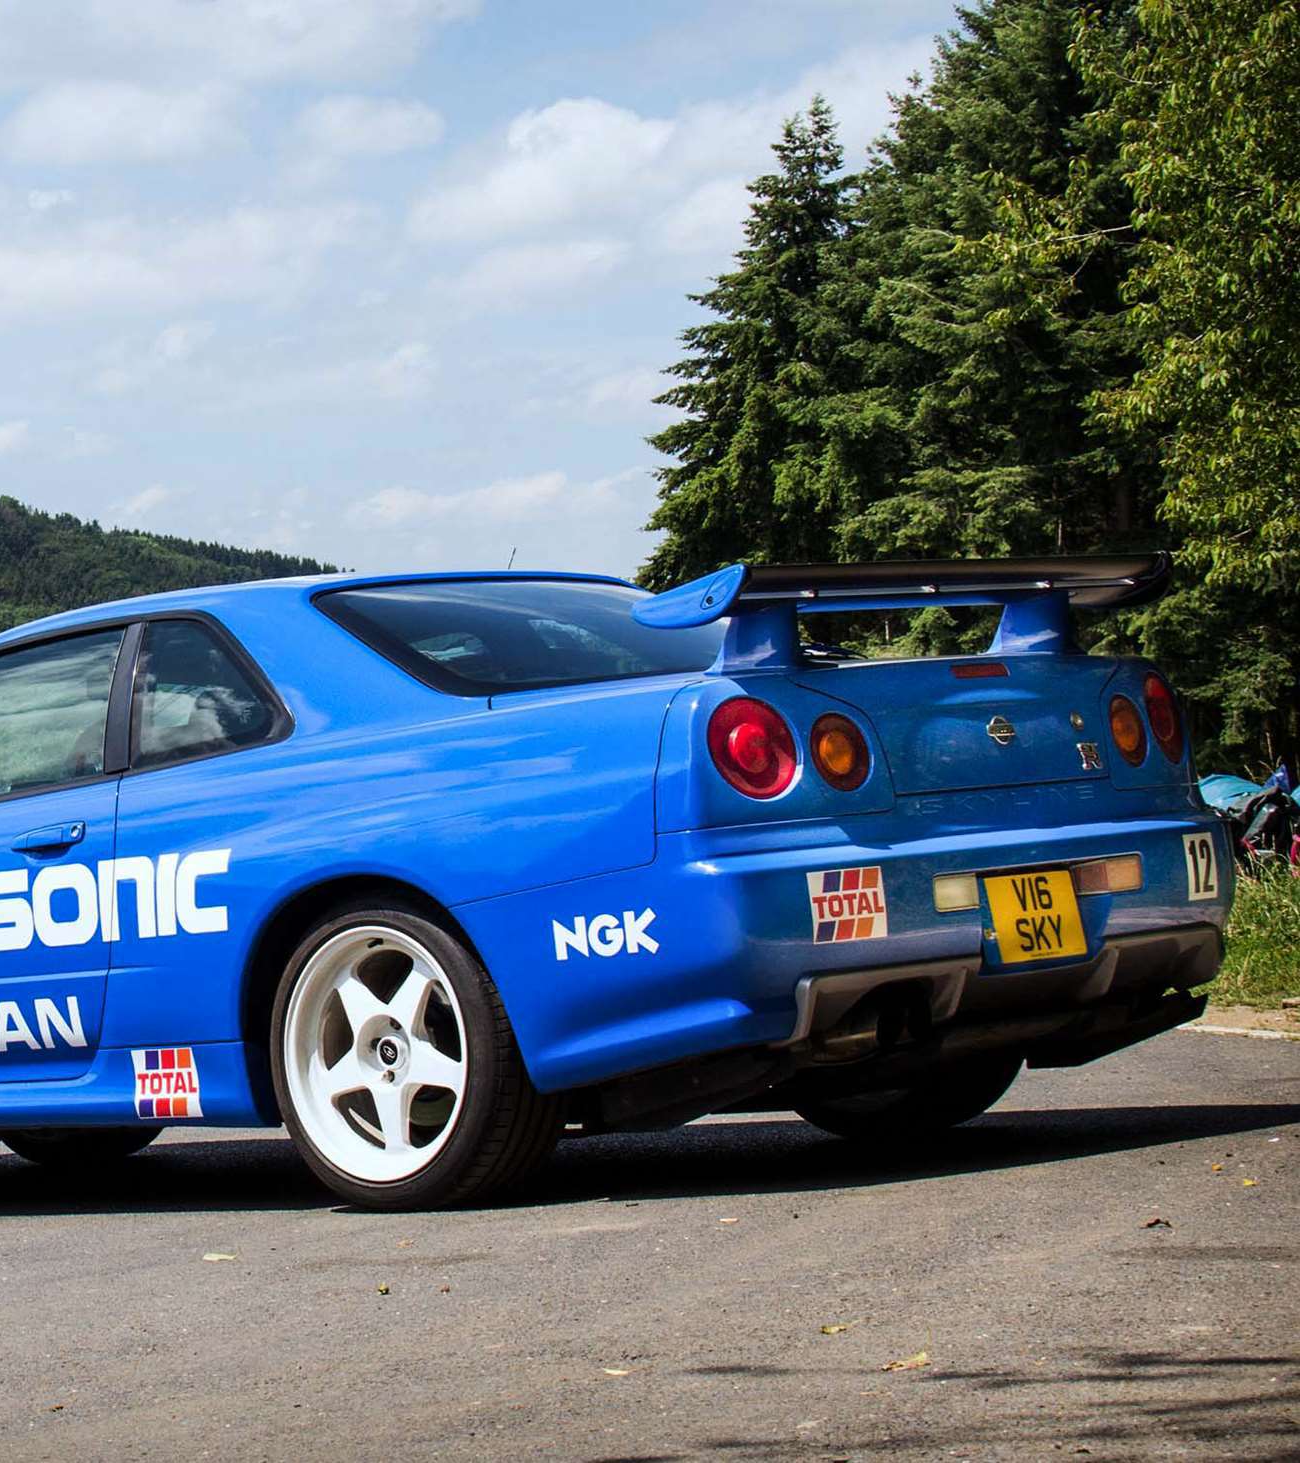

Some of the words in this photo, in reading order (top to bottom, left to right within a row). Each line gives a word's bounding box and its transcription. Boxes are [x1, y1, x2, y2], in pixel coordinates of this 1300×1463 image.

[1188, 839, 1215, 894] 12
[812, 891, 885, 920] TOTAL
[1011, 876, 1053, 912] V16
[552, 907, 660, 961] NGK
[1016, 914, 1063, 952] SKY
[137, 1071, 198, 1095] TOTAL
